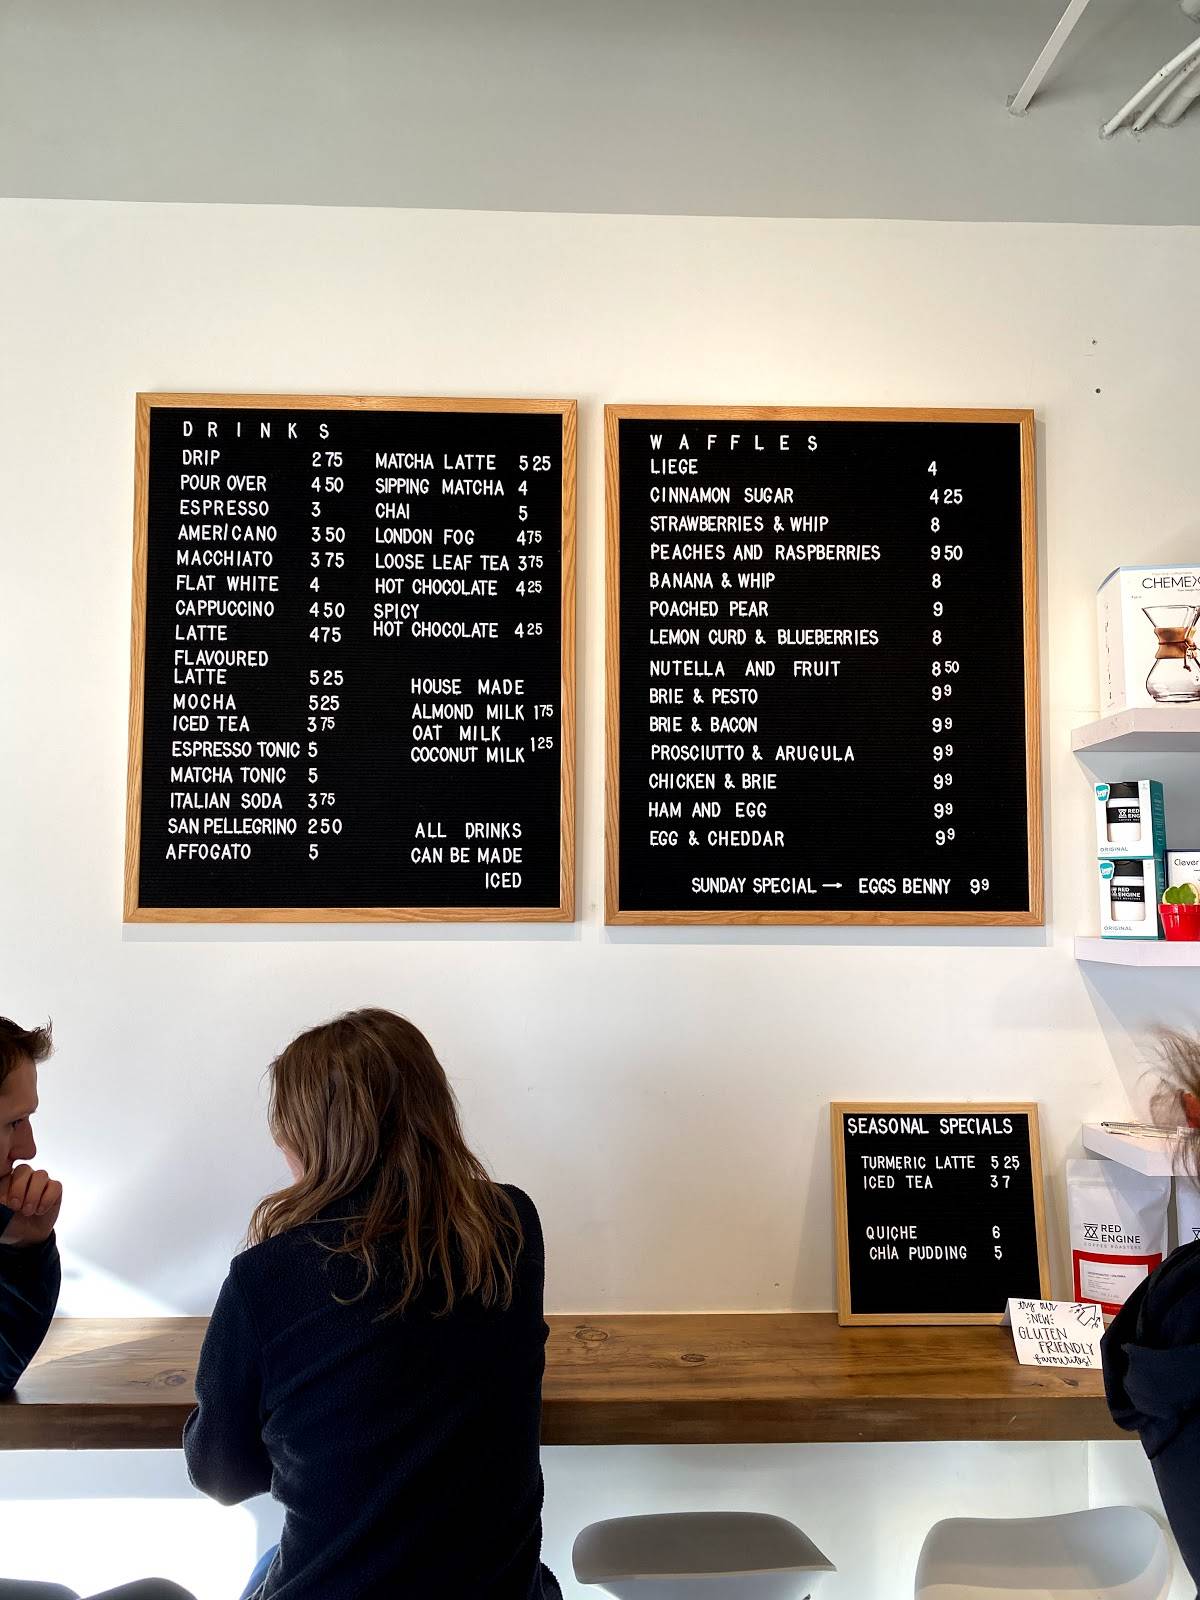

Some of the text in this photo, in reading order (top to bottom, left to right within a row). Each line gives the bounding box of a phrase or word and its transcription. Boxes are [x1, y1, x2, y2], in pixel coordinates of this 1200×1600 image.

[182, 449, 221, 467] DRIP
[375, 452, 497, 471] MATCHA LATTE
[650, 458, 938, 477] LIEGE 4
[180, 474, 267, 492] POUR OVER
[375, 477, 528, 497] SIPPING MATCHA 4
[649, 486, 794, 504] CINNAMON SUGAR
[179, 499, 321, 518] ESPRESSO 3
[375, 502, 528, 522] CHAI 5
[177, 522, 278, 542] AMERICANO
[650, 514, 941, 534] STRAWBERRIES & WHIP 8
[375, 526, 433, 545] LONDON
[443, 528, 475, 546] FOG
[176, 549, 273, 568] MACCHIATO
[650, 542, 881, 562] PEACHES AND RASPBERRIES
[375, 552, 425, 570] LOOSE
[432, 554, 473, 572] LEAF
[479, 554, 510, 572] TEA
[176, 574, 320, 593] FLAT WHITE 4
[375, 577, 498, 597] HOT CHOCOLATE
[649, 571, 942, 590] BANANA & WHIP 8
[175, 599, 275, 618] CAPPUCCINO
[373, 602, 420, 620] SPICY
[649, 600, 944, 618] POACHED PEAR 9
[175, 623, 228, 642] LATTE
[373, 619, 499, 639] HOT CHOCOLATE
[649, 628, 943, 647] LEMON CURD & BLUEBERRIES 8
[174, 649, 269, 668] FLAVOURED
[173, 667, 228, 686] LATTE
[649, 659, 726, 678] NUTELLA
[744, 659, 776, 678] AND
[793, 660, 841, 678] FRUIT
[411, 677, 525, 696] HOUSE MADE
[649, 687, 684, 705] BRIE
[692, 687, 705, 705] &
[711, 687, 759, 705] PESTO
[173, 693, 237, 711] MOCHA
[411, 702, 474, 721] ALMOND
[486, 703, 525, 721] MILK
[172, 714, 210, 732] ICED
[216, 715, 250, 733] TEA
[412, 723, 502, 743] OAT MILK
[649, 715, 758, 734] BRIE & BACON
[171, 740, 318, 759] ESPRESSO TONIC 5
[410, 745, 525, 764] COCONUT MILK
[651, 743, 855, 763] PROSCIUTTO & ARUGULA
[170, 766, 319, 784] MATCHA TONIC 5
[648, 772, 716, 790] CHICKEN
[724, 772, 736, 790] &
[741, 772, 777, 791] BRIE
[170, 791, 231, 810] ITALIAN
[240, 792, 283, 810] SODA
[648, 801, 767, 819] HAM AND EGG
[167, 816, 200, 835] SAN
[203, 816, 298, 836] PELLEGRINO
[414, 821, 522, 840] ALL DRINKS
[649, 829, 785, 848] EGG & CHEDDAR
[165, 842, 319, 861] AFFOGATO 5
[410, 846, 523, 865] CAN BE MADE
[485, 871, 522, 890] ICED
[691, 876, 951, 896] SUNDAY SPECIAL EGGS BENNY
[847, 1117, 1013, 1137] SEASONAL SPECIALS
[860, 1155, 976, 1171] TURMERIC LATTE
[863, 1174, 934, 1190] ICED TEA
[865, 1224, 1001, 1241] QUICHE 6
[1101, 1224, 1122, 1233] RED
[1101, 1234, 1141, 1244] ENGINE
[869, 1243, 1003, 1261] CHIA PUDDING 5
[1030, 1313, 1050, 1325] NEW
[1018, 1326, 1068, 1340] GLUTEN
[1038, 1341, 1094, 1355] FRIENDLY
